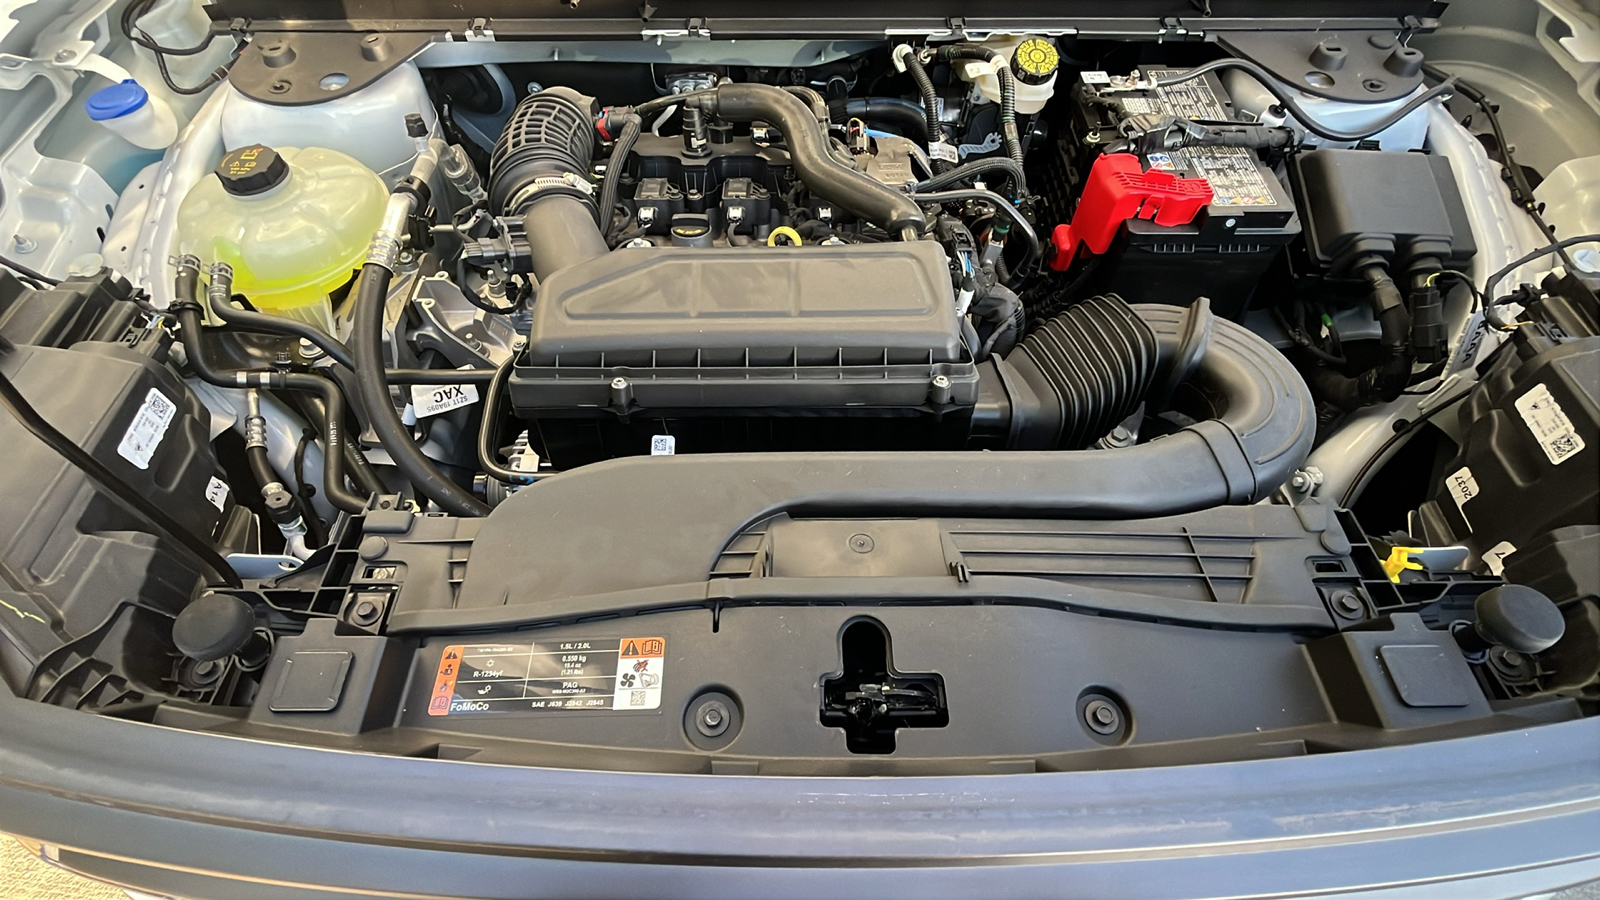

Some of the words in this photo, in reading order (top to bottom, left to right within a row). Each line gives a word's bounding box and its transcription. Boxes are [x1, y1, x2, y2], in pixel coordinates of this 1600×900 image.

[433, 384, 464, 403] XAC
[1454, 475, 1473, 499] 2037
[473, 670, 503, 678] R-1234yf
[450, 702, 489, 711] FoMoCo
